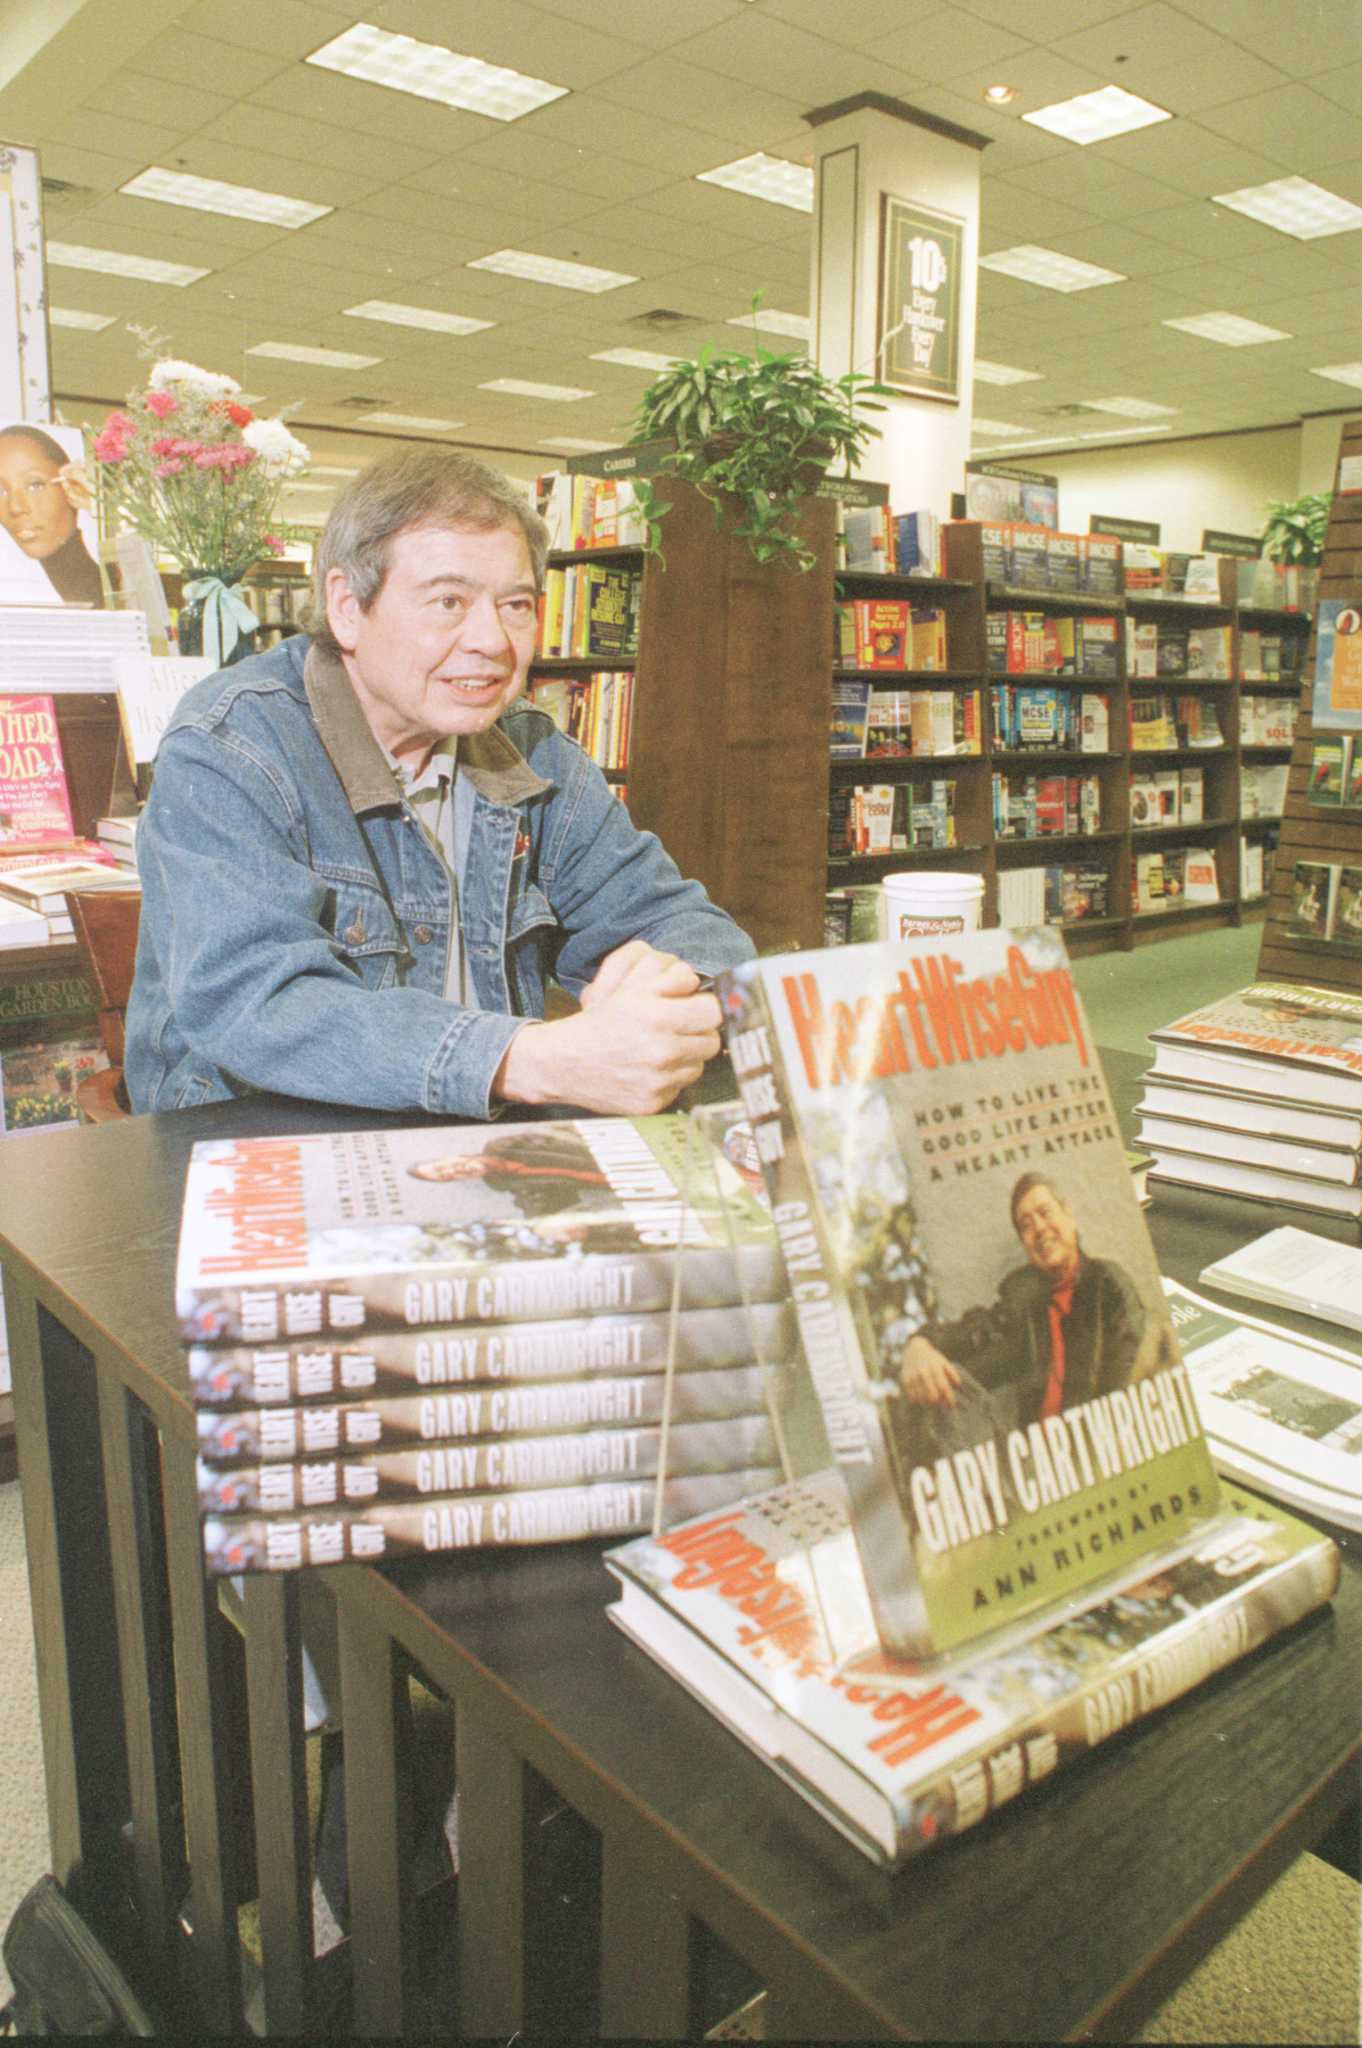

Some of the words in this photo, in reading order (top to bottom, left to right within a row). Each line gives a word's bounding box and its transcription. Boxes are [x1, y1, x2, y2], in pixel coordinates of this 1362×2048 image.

[914, 1102, 964, 1127] HOW
[979, 1093, 1002, 1114] TO
[1010, 1083, 1058, 1107] LIVE
[1067, 1074, 1101, 1095] THE
[922, 1128, 982, 1155] GOOD
[993, 1114, 1039, 1139] LIFE
[1050, 1099, 1109, 1126] AFTER
[930, 1165, 944, 1183] A
[956, 1144, 1032, 1176] HEART
[1044, 1124, 1118, 1153] ATTACK
[773, 1200, 824, 1279] GARY
[404, 1278, 469, 1325] GARY
[415, 1336, 479, 1384] GARY
[420, 1392, 482, 1440] GARY
[416, 1446, 478, 1493] GARY
[911, 1440, 1008, 1553] GARY
[1007, 1364, 1202, 1513] CARTWRIGHT
[422, 1502, 483, 1551] GARY
[972, 1564, 1037, 1610] ANN
[1052, 1484, 1202, 1570] RICHARDS
